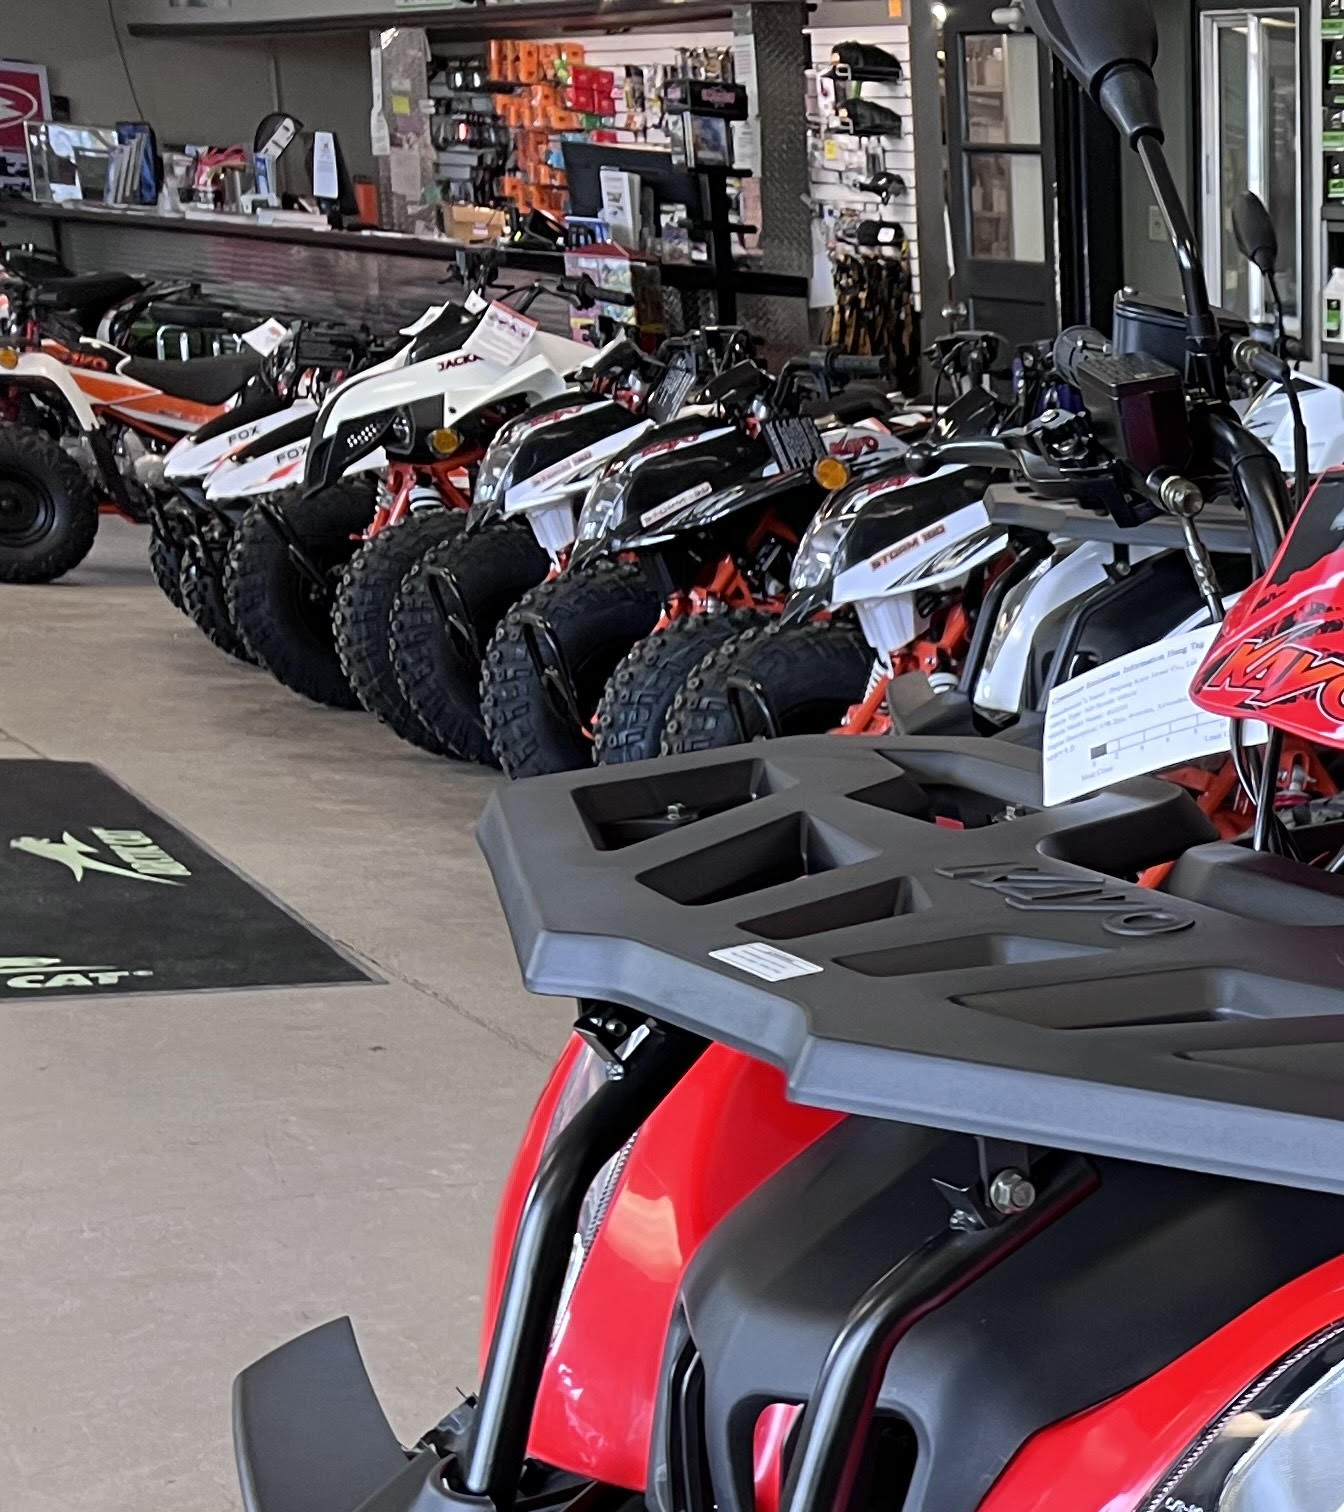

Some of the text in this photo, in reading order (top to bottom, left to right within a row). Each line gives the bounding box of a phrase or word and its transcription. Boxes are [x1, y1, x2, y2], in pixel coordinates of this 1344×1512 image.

[227, 424, 263, 446] FOX
[870, 538, 920, 572] STORM
[934, 861, 1195, 937] KAYO
[6, 970, 130, 989] CAT
